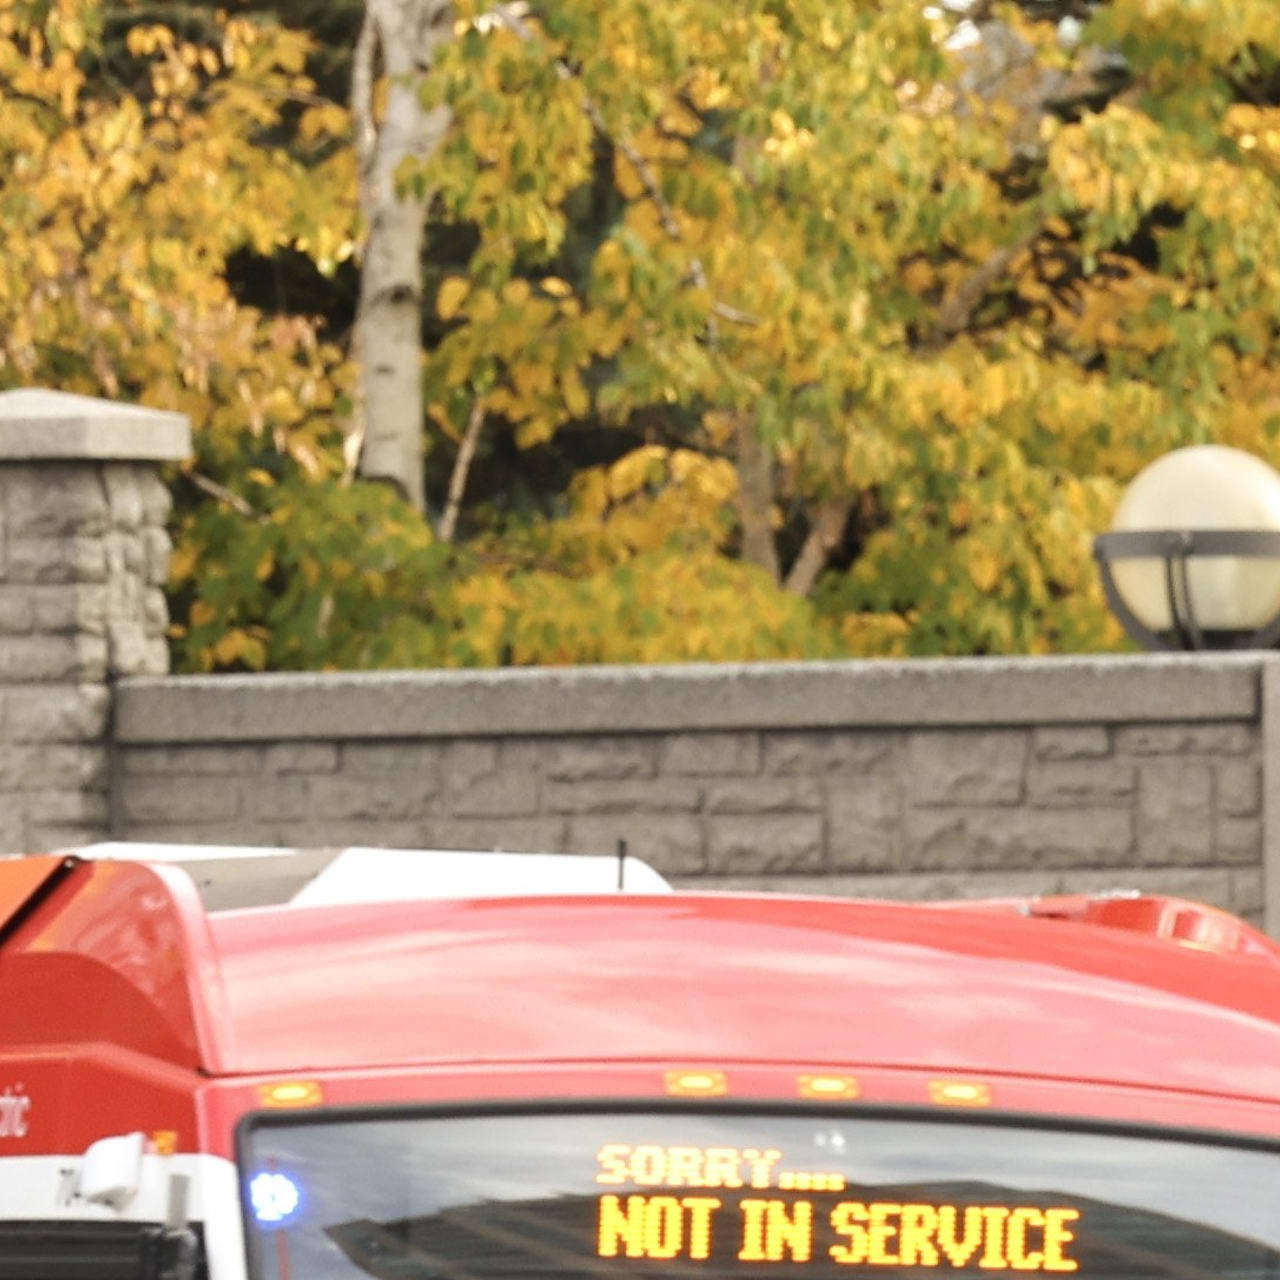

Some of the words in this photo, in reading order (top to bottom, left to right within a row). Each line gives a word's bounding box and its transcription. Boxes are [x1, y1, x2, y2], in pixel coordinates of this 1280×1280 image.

[597, 1194, 721, 1260] NOT
[737, 1199, 813, 1262] IN
[827, 1202, 1081, 1273] SERVICE
